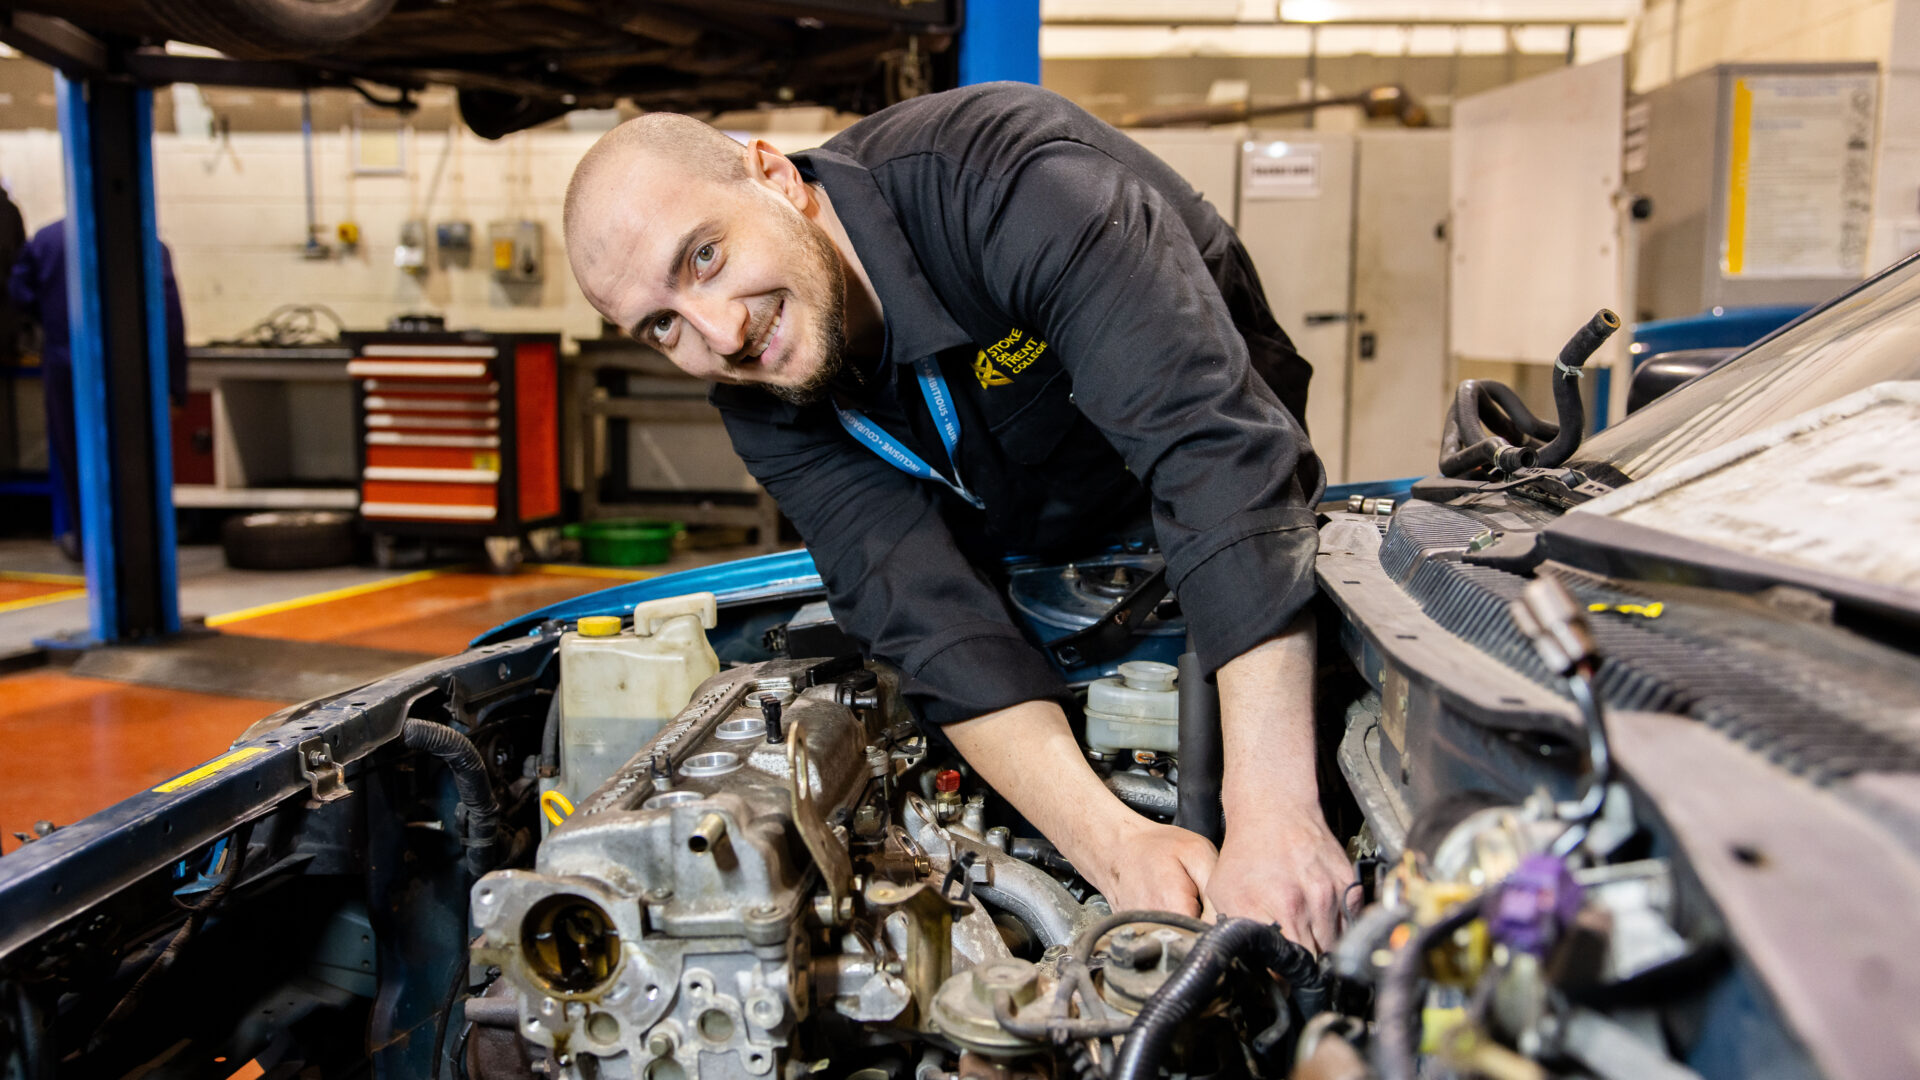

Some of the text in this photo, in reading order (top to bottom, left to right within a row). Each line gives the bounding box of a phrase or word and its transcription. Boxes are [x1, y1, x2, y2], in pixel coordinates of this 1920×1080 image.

[987, 328, 1023, 358] STOKE
[996, 352, 1010, 362] ON
[1001, 337, 1038, 368] TRENT
[1012, 341, 1048, 374] COLLEGE
[924, 368, 948, 417] AMBITIOUS
[882, 441, 920, 472] INCLUSIVE
